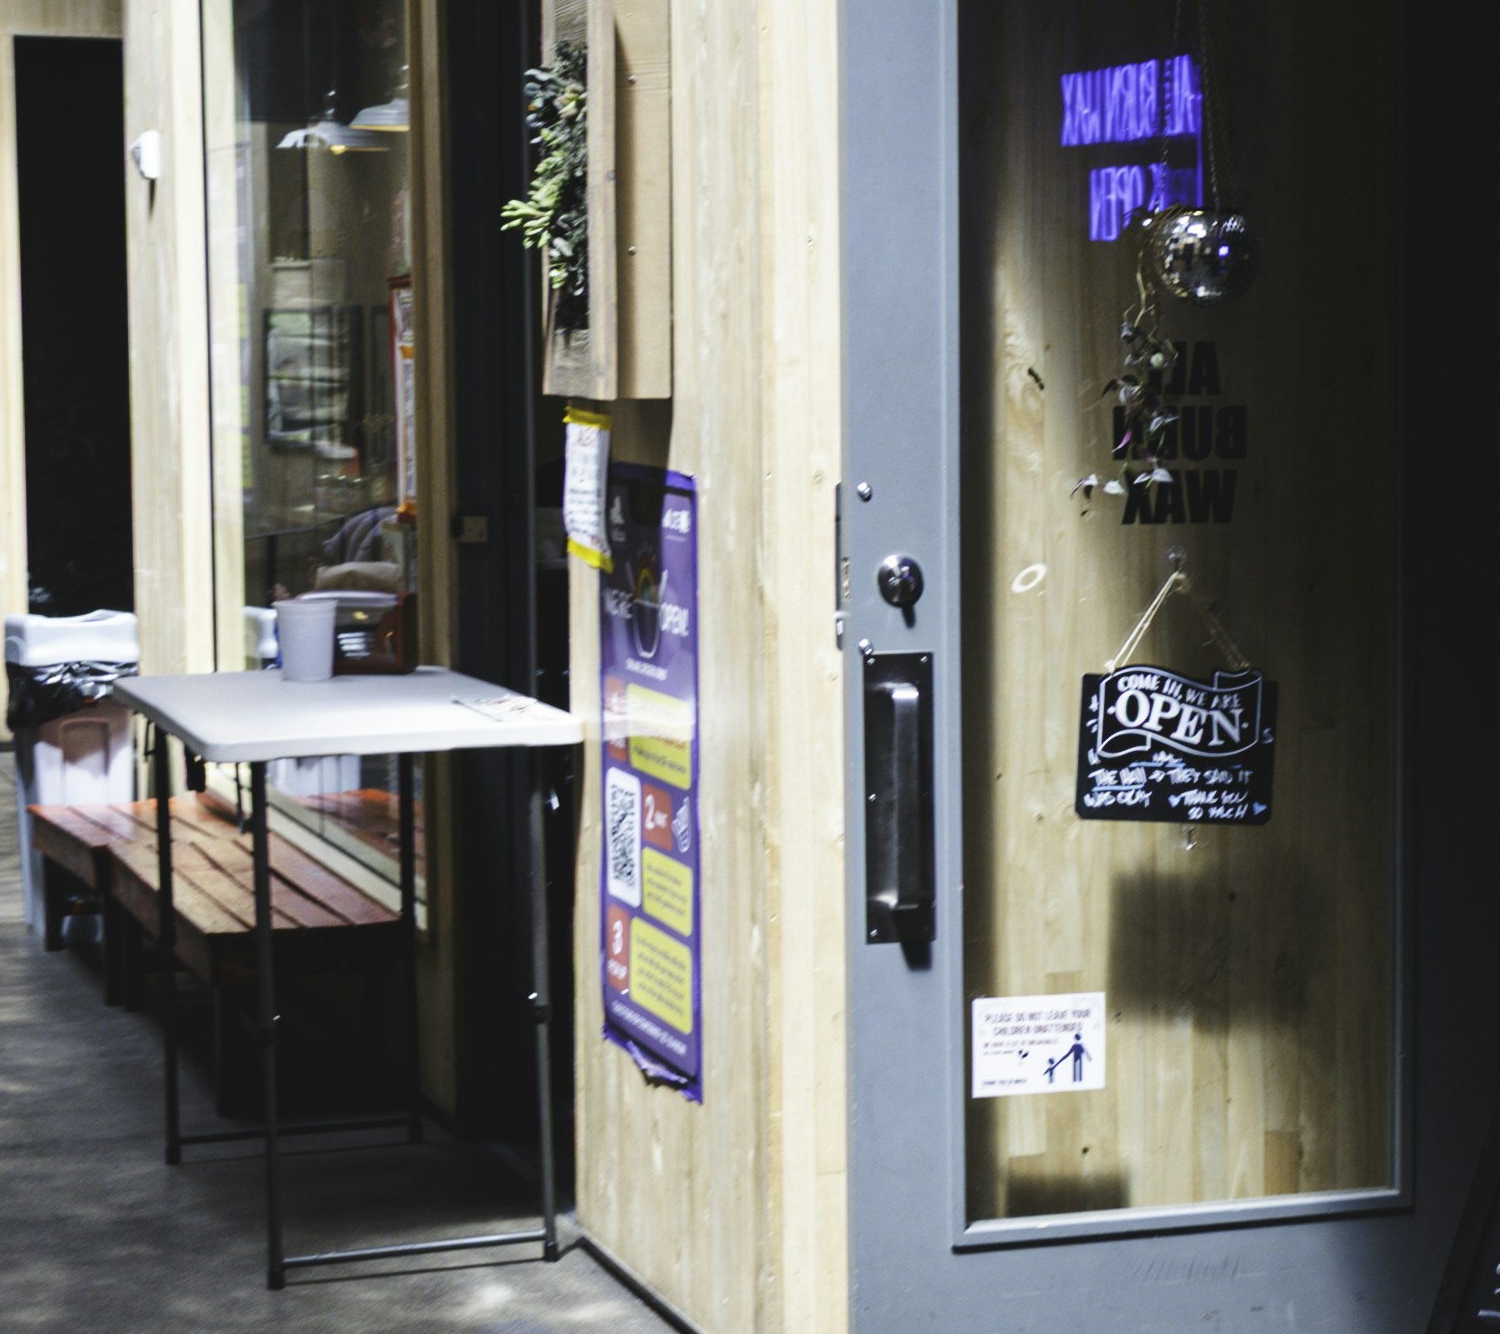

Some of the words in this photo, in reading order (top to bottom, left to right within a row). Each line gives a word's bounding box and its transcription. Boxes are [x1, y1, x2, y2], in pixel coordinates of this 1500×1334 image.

[1116, 673, 1160, 692] COME
[1185, 687, 1207, 705] WE
[1114, 689, 1244, 747] OPEN
